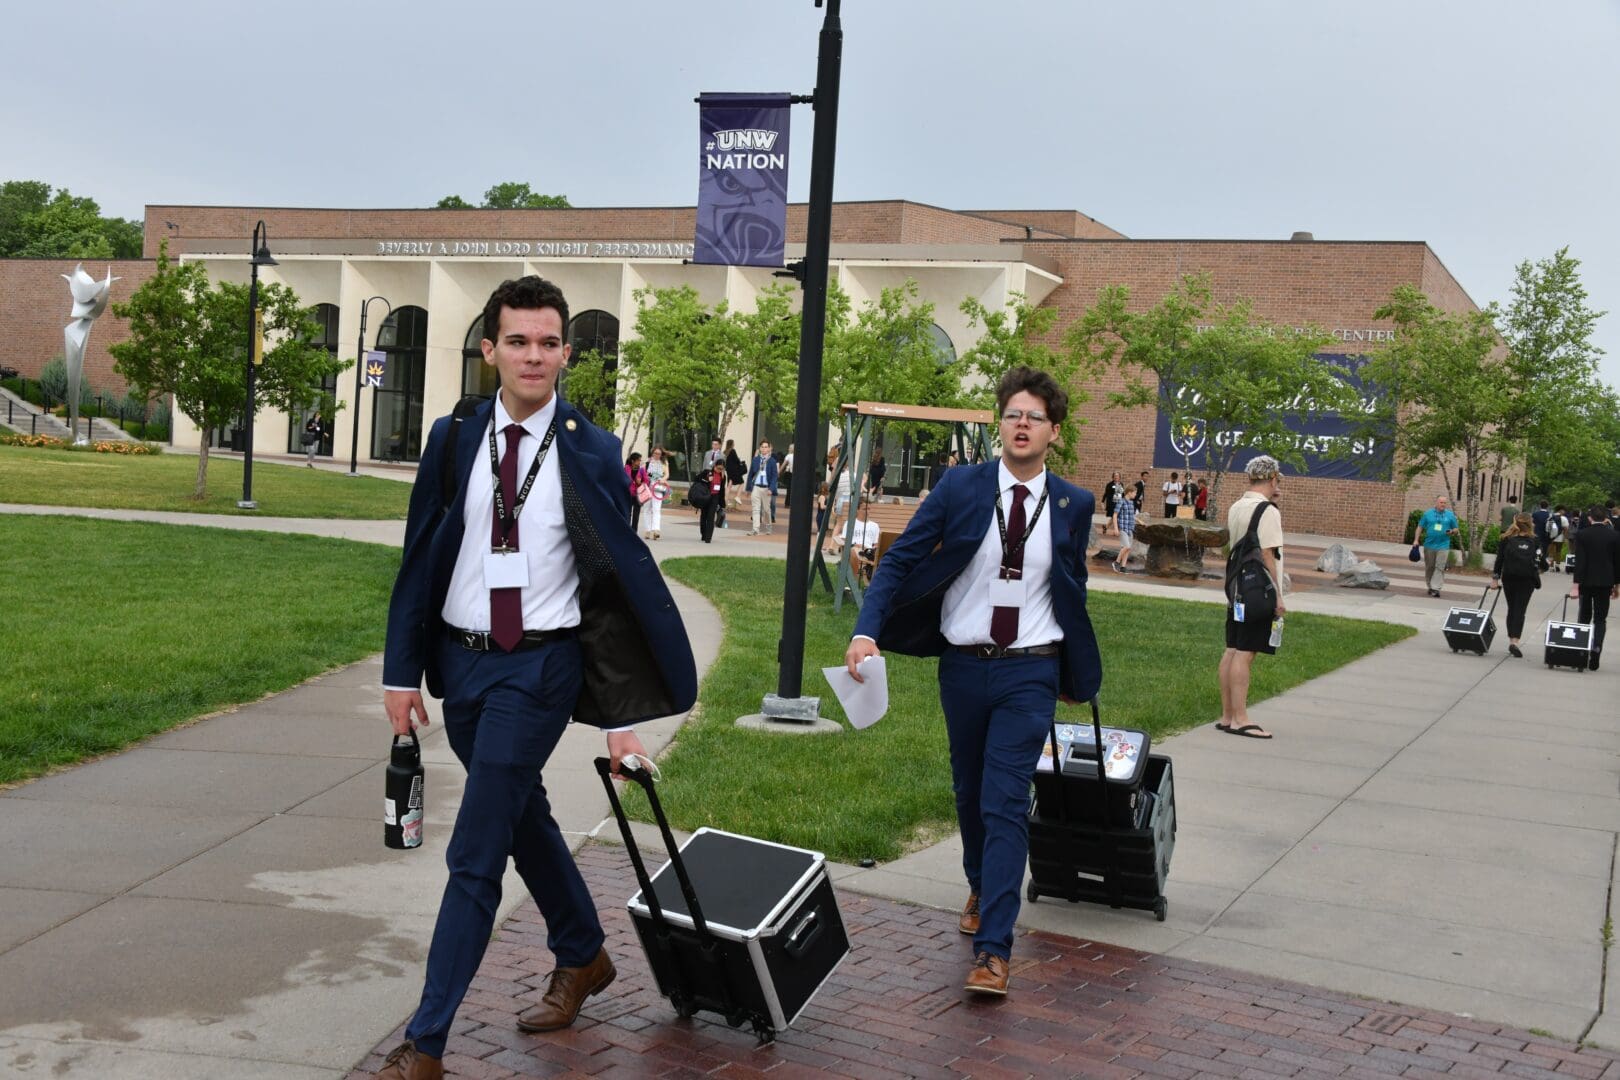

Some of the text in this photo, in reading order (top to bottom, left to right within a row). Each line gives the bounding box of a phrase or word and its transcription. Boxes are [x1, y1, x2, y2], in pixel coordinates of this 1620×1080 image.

[705, 128, 779, 151] #UNW
[707, 153, 785, 170] NATION
[377, 242, 433, 255] BEVERLY
[452, 242, 489, 254] JOHN
[495, 242, 531, 255] LORD
[536, 242, 589, 255] KNIGHT
[593, 243, 695, 256] PERFORMANC
[1332, 328, 1396, 342] CENTER
